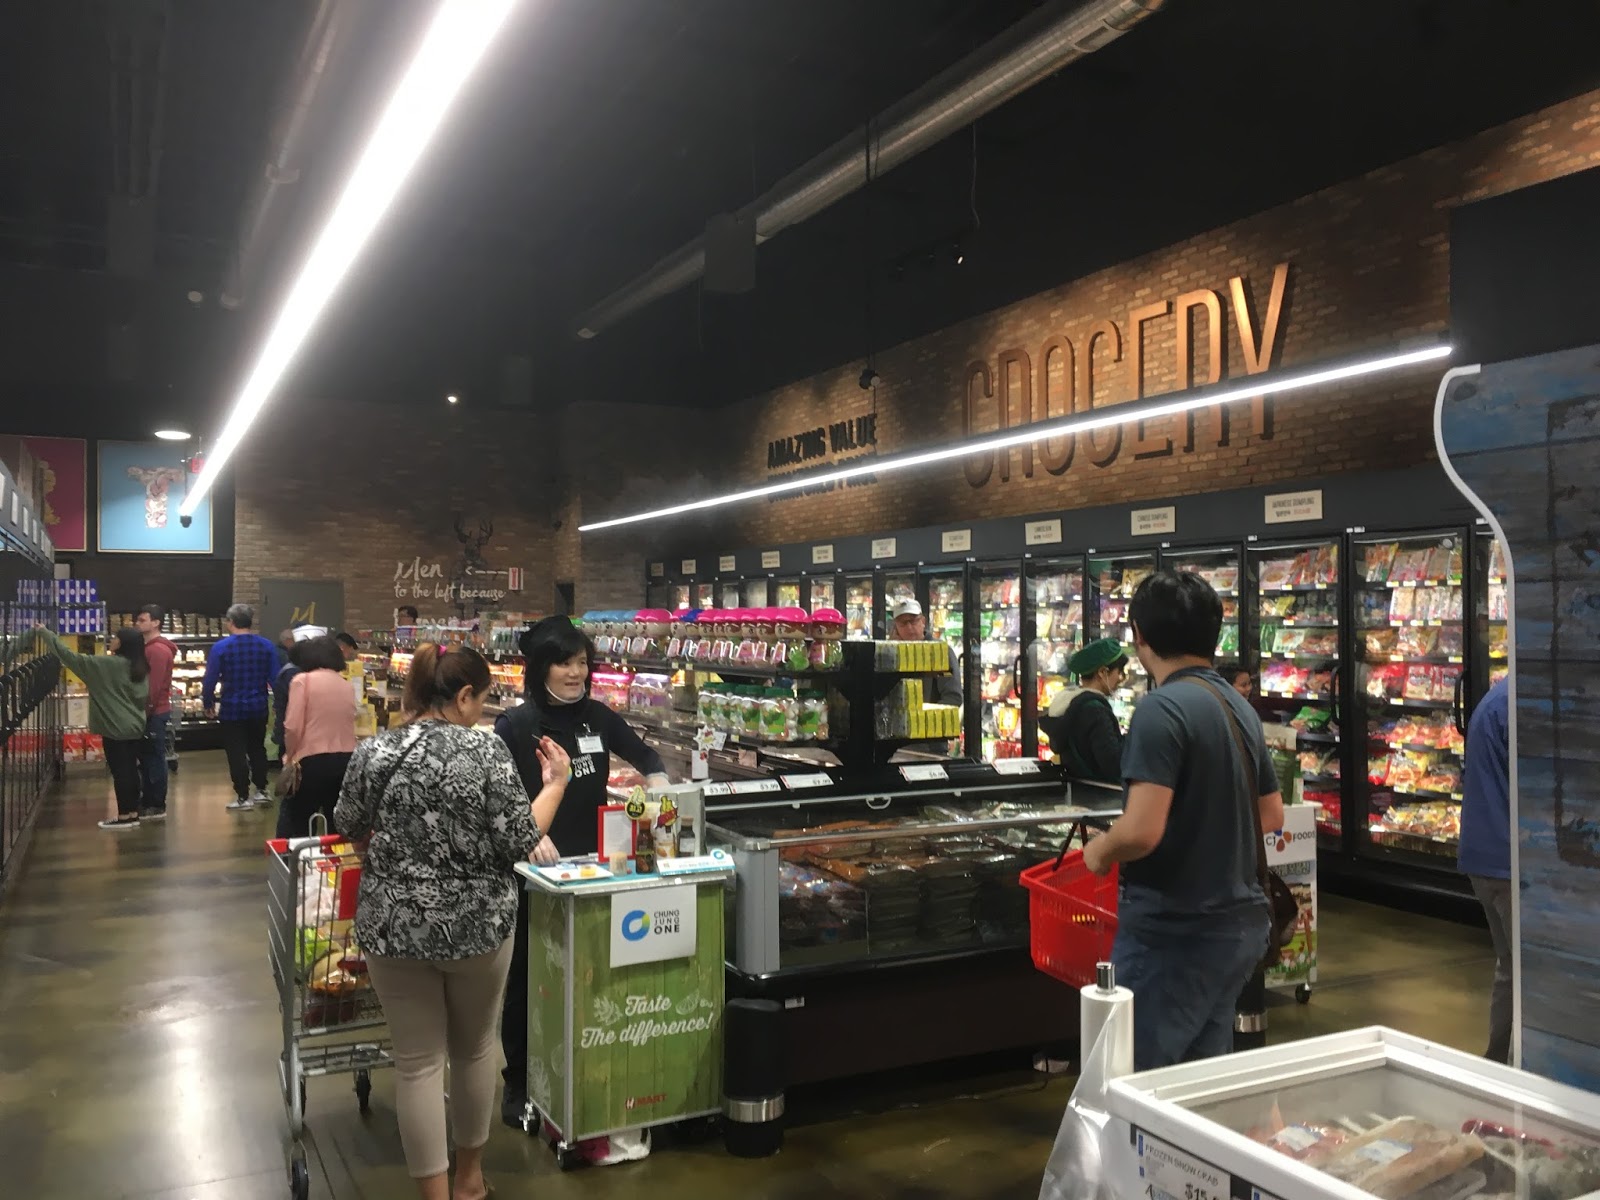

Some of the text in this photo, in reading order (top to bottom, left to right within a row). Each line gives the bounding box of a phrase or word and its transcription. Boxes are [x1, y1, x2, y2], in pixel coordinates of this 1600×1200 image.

[961, 262, 1290, 488] GROCERY
[767, 413, 878, 469] AMAZING VALUE
[394, 556, 443, 582] Men
[394, 582, 506, 603] to the left because
[574, 765, 596, 778] ONE
[1266, 830, 1316, 847] CJ FOODS
[654, 909, 680, 919] CHUNG
[654, 917, 680, 926] JUNG
[654, 924, 680, 935] ONE
[625, 994, 672, 1016] Taste
[581, 1012, 714, 1049] The difference!
[1145, 1144, 1173, 1165] FROZEN
[1174, 1159, 1196, 1176] SNOW
[1197, 1170, 1219, 1187] CRAB
